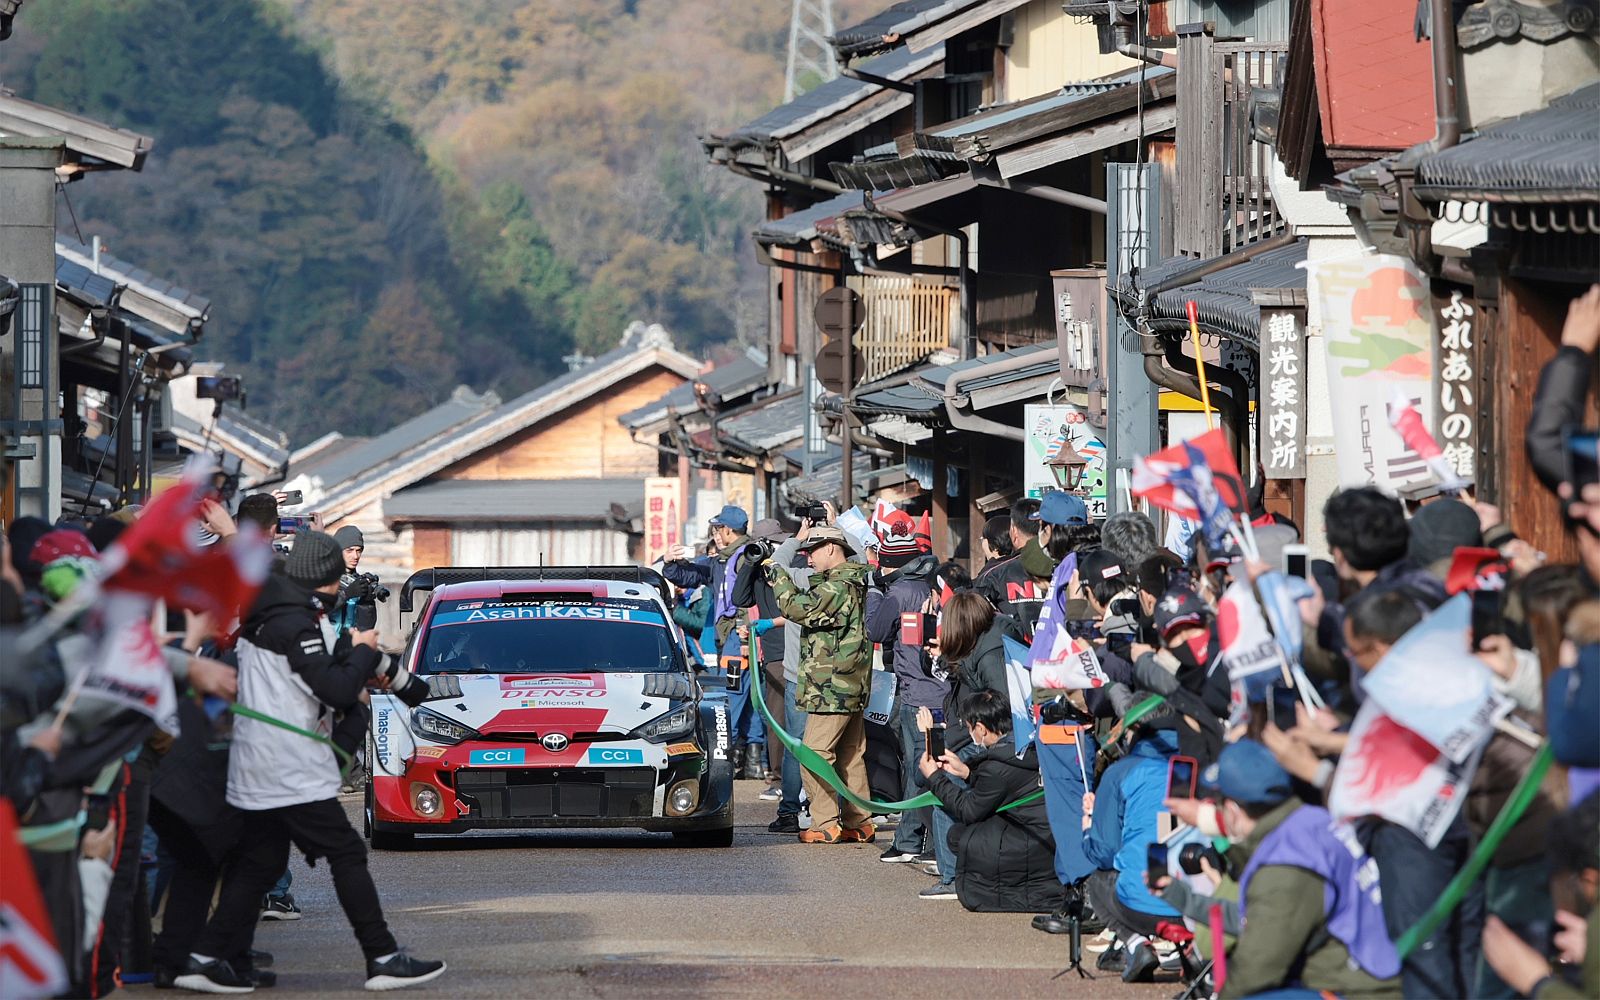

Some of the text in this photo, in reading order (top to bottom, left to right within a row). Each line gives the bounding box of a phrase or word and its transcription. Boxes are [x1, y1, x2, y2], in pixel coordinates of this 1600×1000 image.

[1268, 313, 1298, 469] 観光案内所
[1441, 290, 1474, 476] ふれあいの館
[594, 602, 640, 610] Racing
[502, 689, 607, 698] DENSO
[868, 711, 889, 722] 2023
[378, 708, 392, 765] anasonic
